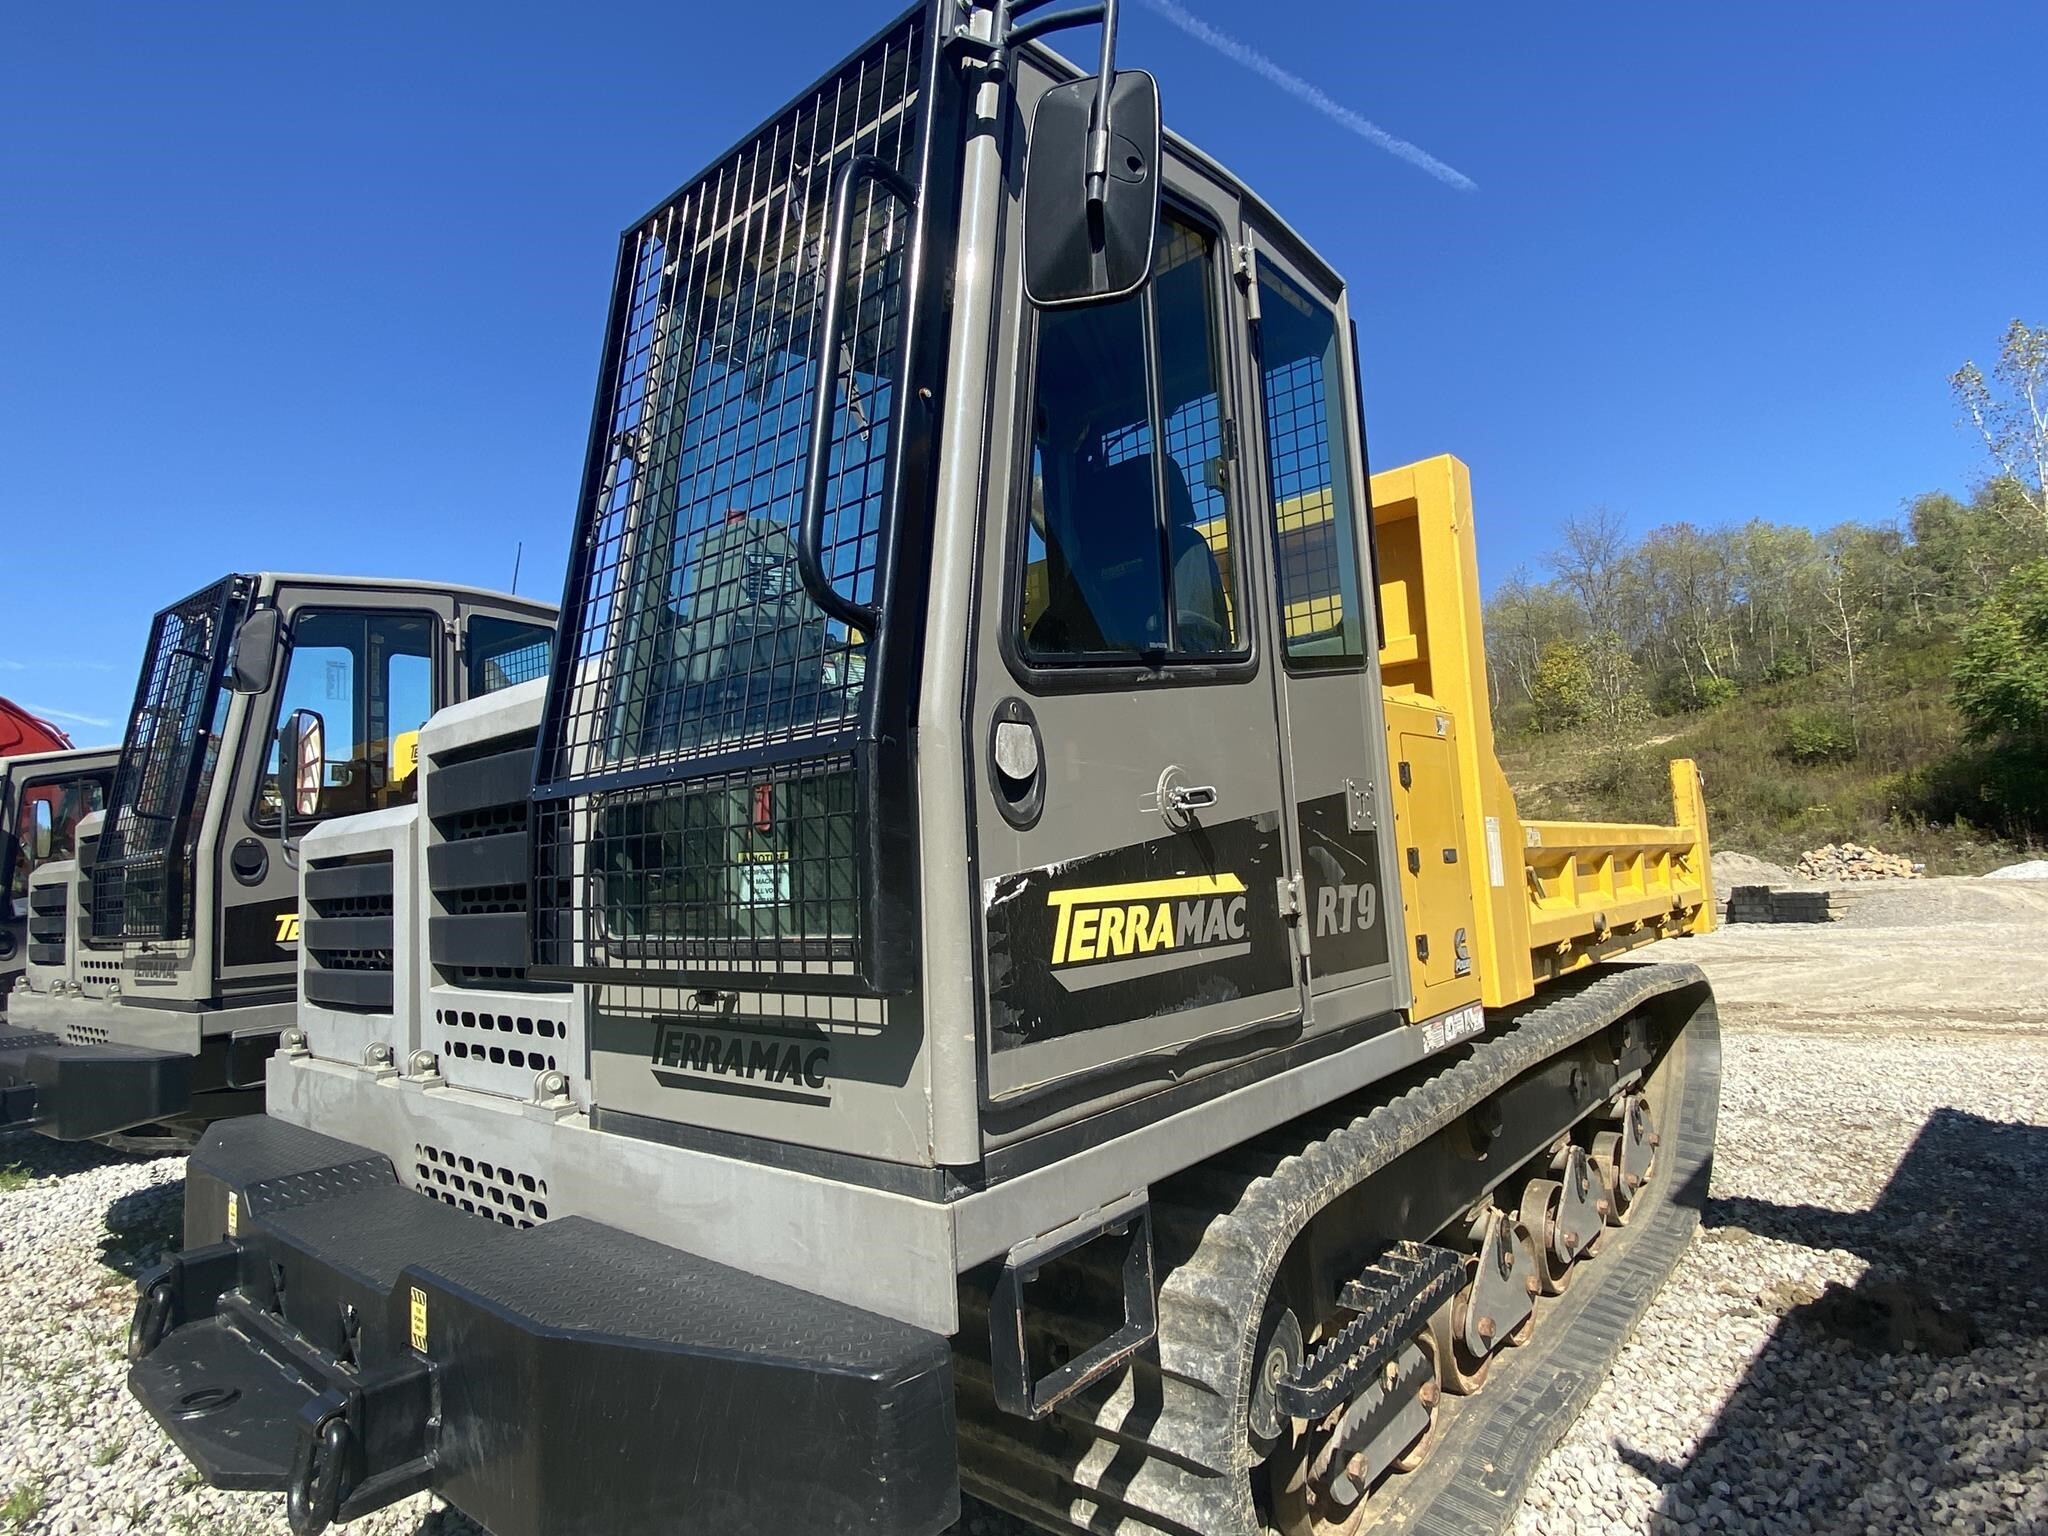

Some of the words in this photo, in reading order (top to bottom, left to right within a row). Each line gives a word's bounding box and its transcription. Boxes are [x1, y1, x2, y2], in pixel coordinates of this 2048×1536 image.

[1047, 872, 1248, 965] TERRAMAC
[1316, 882, 1377, 937] RT9
[650, 1015, 831, 1090] TERRAMAC
